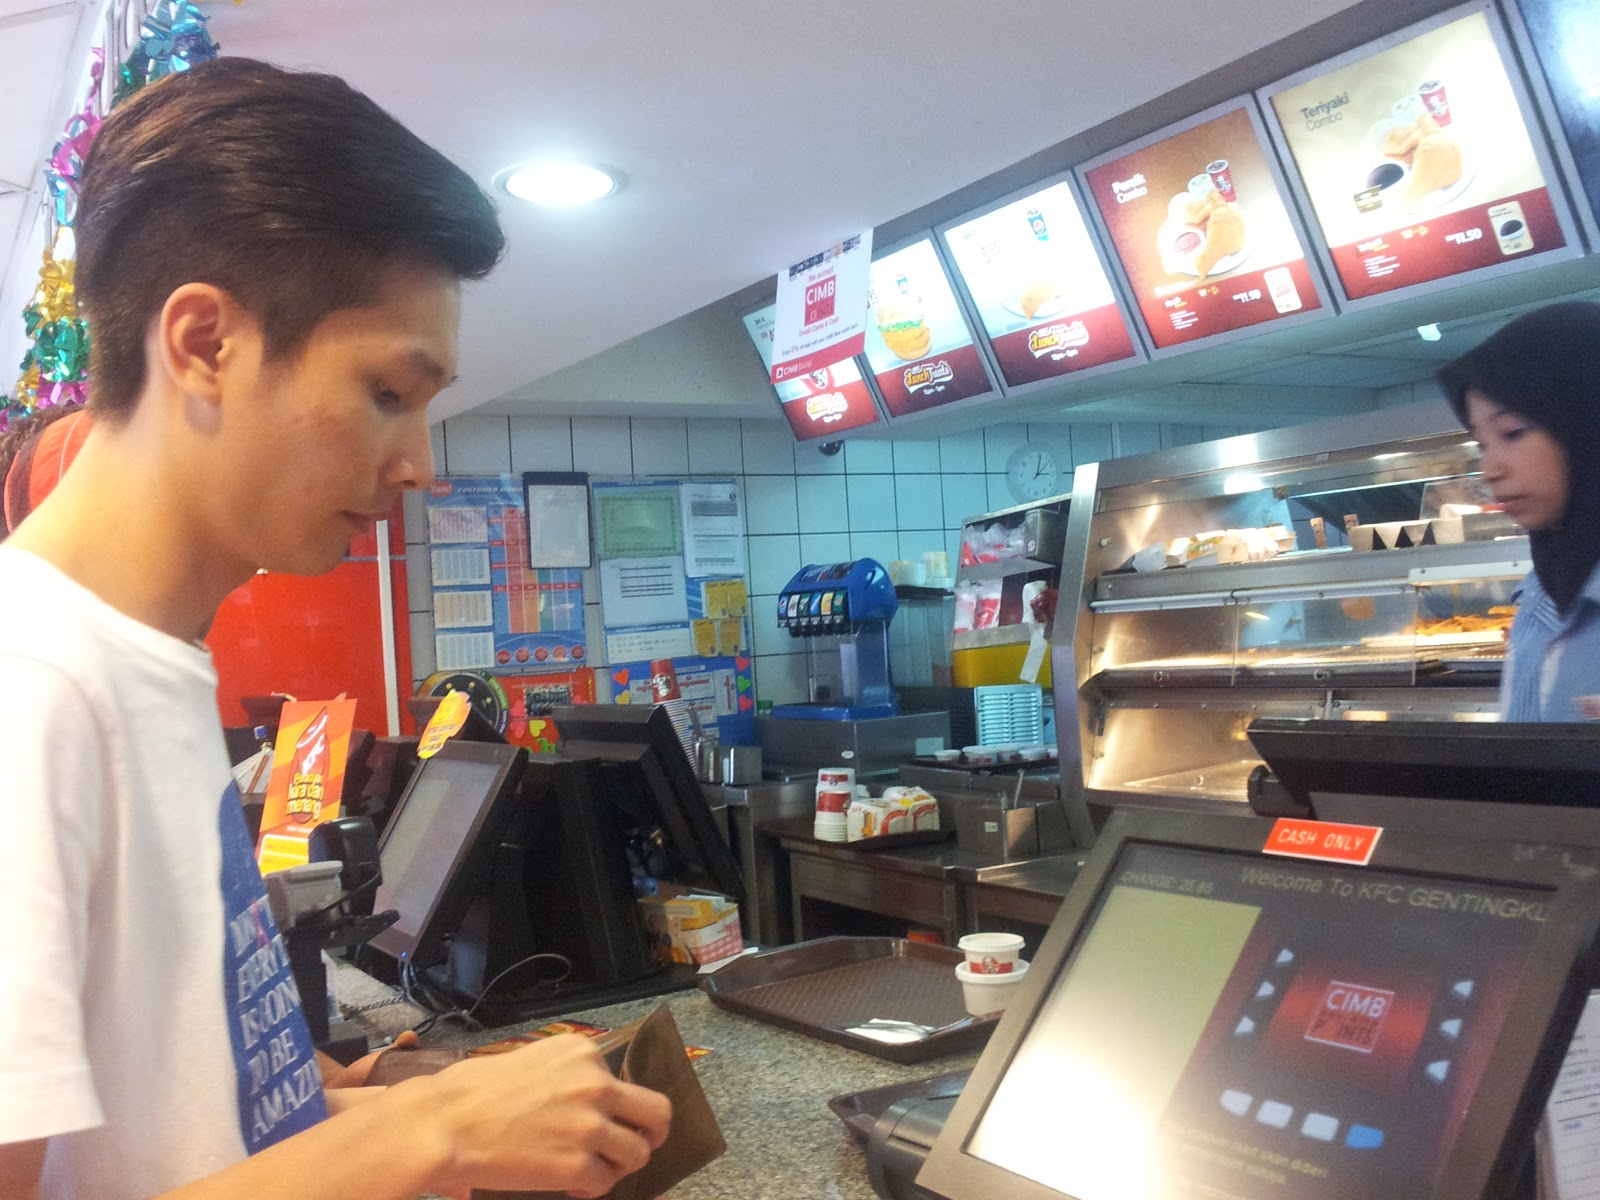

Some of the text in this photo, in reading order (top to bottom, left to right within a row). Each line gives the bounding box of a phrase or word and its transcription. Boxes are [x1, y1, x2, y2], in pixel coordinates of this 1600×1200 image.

[1301, 91, 1350, 120] Teriyaki
[1305, 112, 1343, 132] Combo
[806, 280, 835, 306] CIMB
[1277, 828, 1365, 851] CASH ONLY
[1241, 866, 1324, 894] Welcome
[1330, 877, 1354, 897] To
[1358, 882, 1406, 904] KFC
[1326, 988, 1387, 1019] CIMB
[270, 1028, 299, 1076] BE
